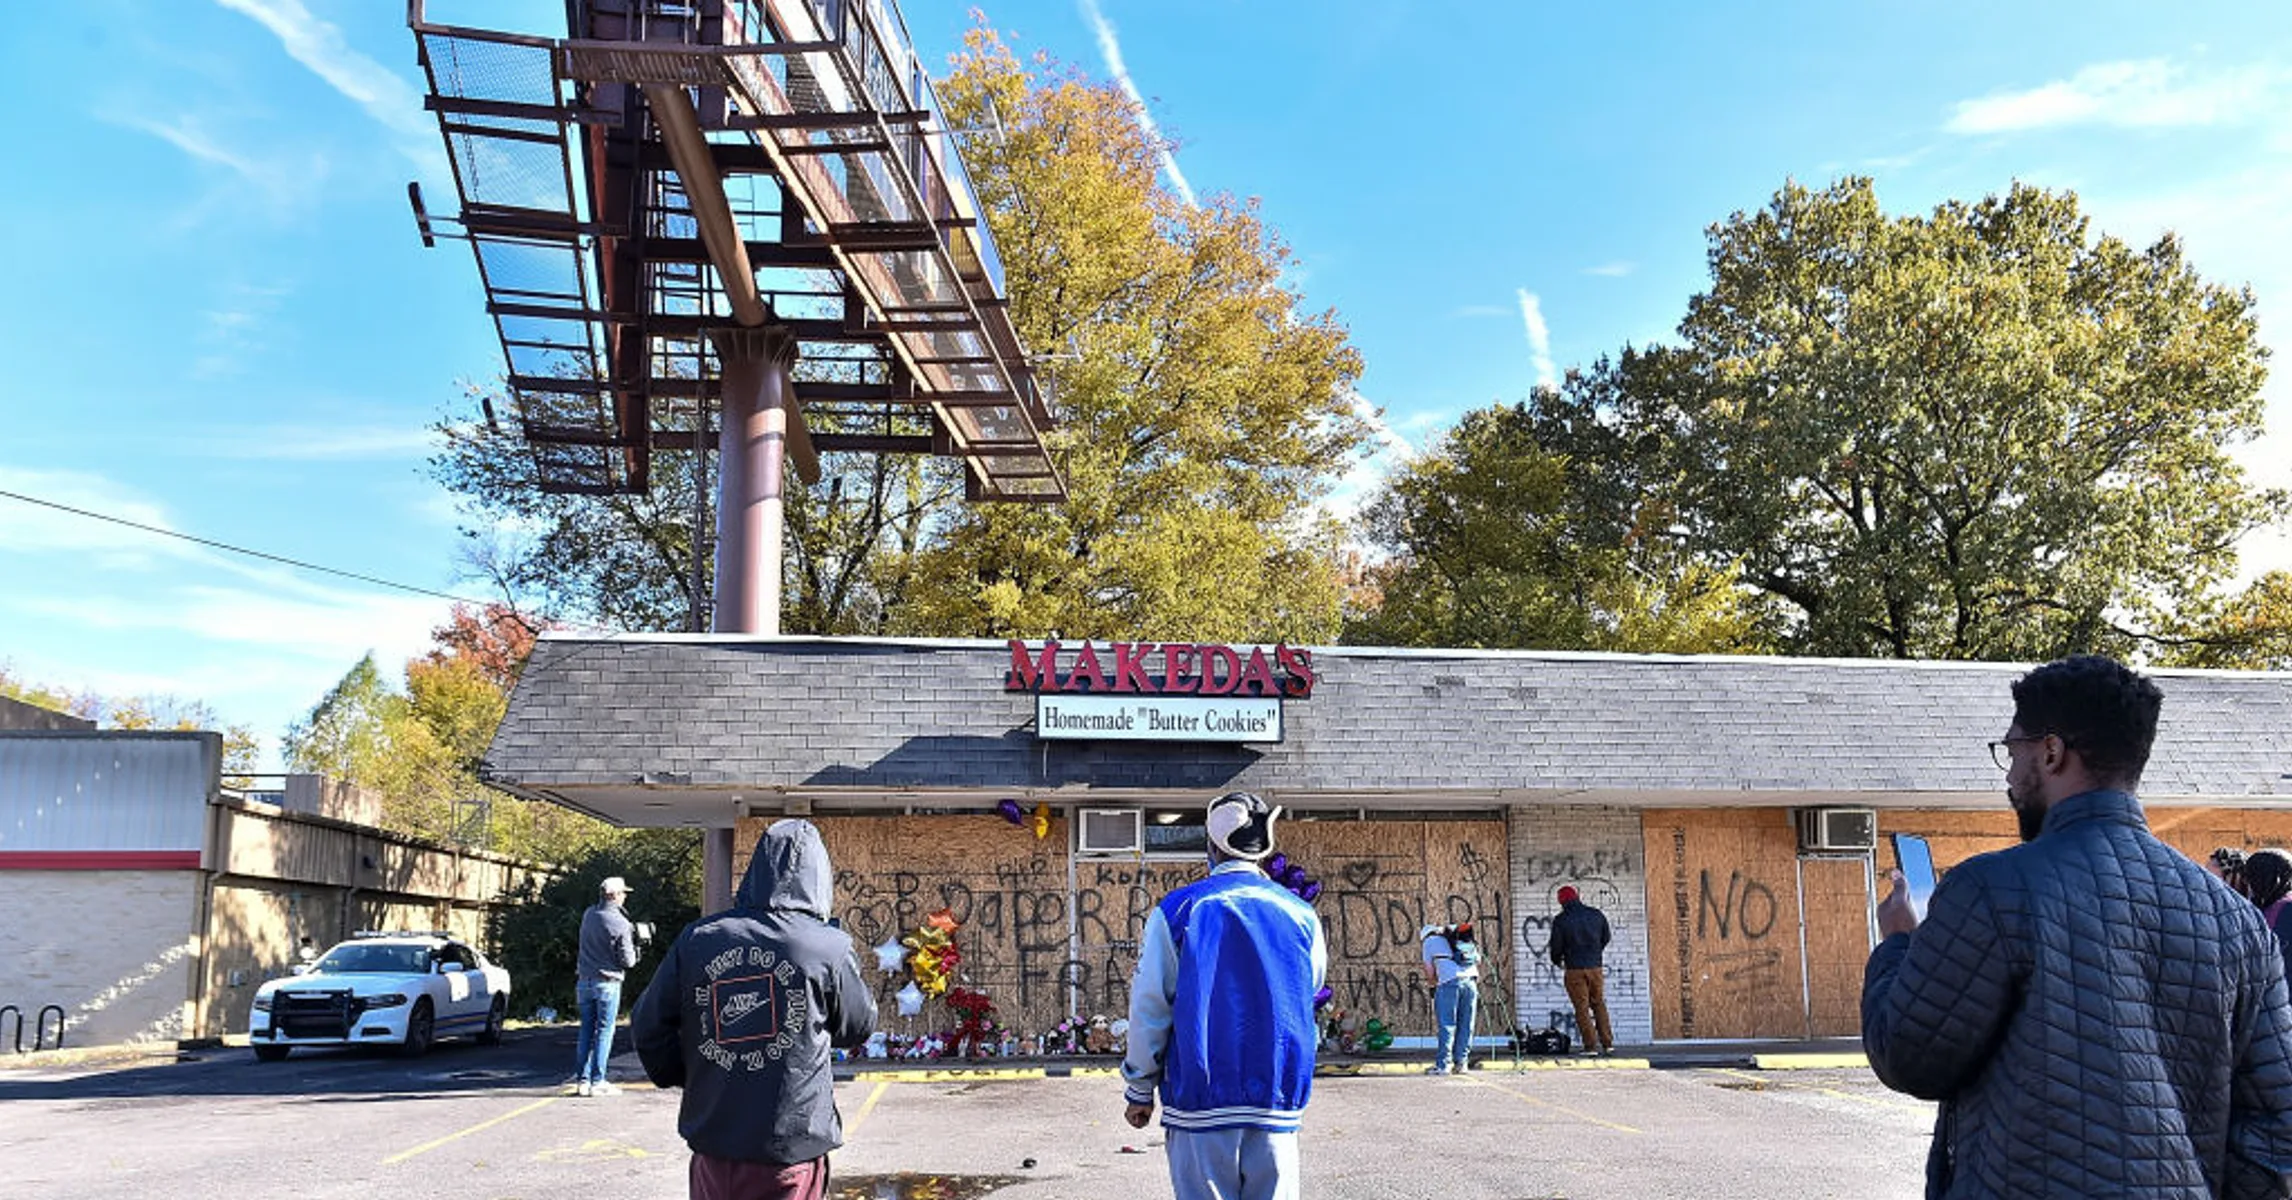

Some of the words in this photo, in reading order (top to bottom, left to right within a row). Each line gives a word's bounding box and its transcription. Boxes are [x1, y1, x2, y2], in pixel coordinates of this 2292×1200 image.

[1007, 639, 1314, 696] MAKEDA'S
[1045, 707, 1134, 731] Homemade
[1205, 708, 1276, 732] Cookies"
[1697, 868, 1777, 940] NO
[749, 946, 775, 968] DO
